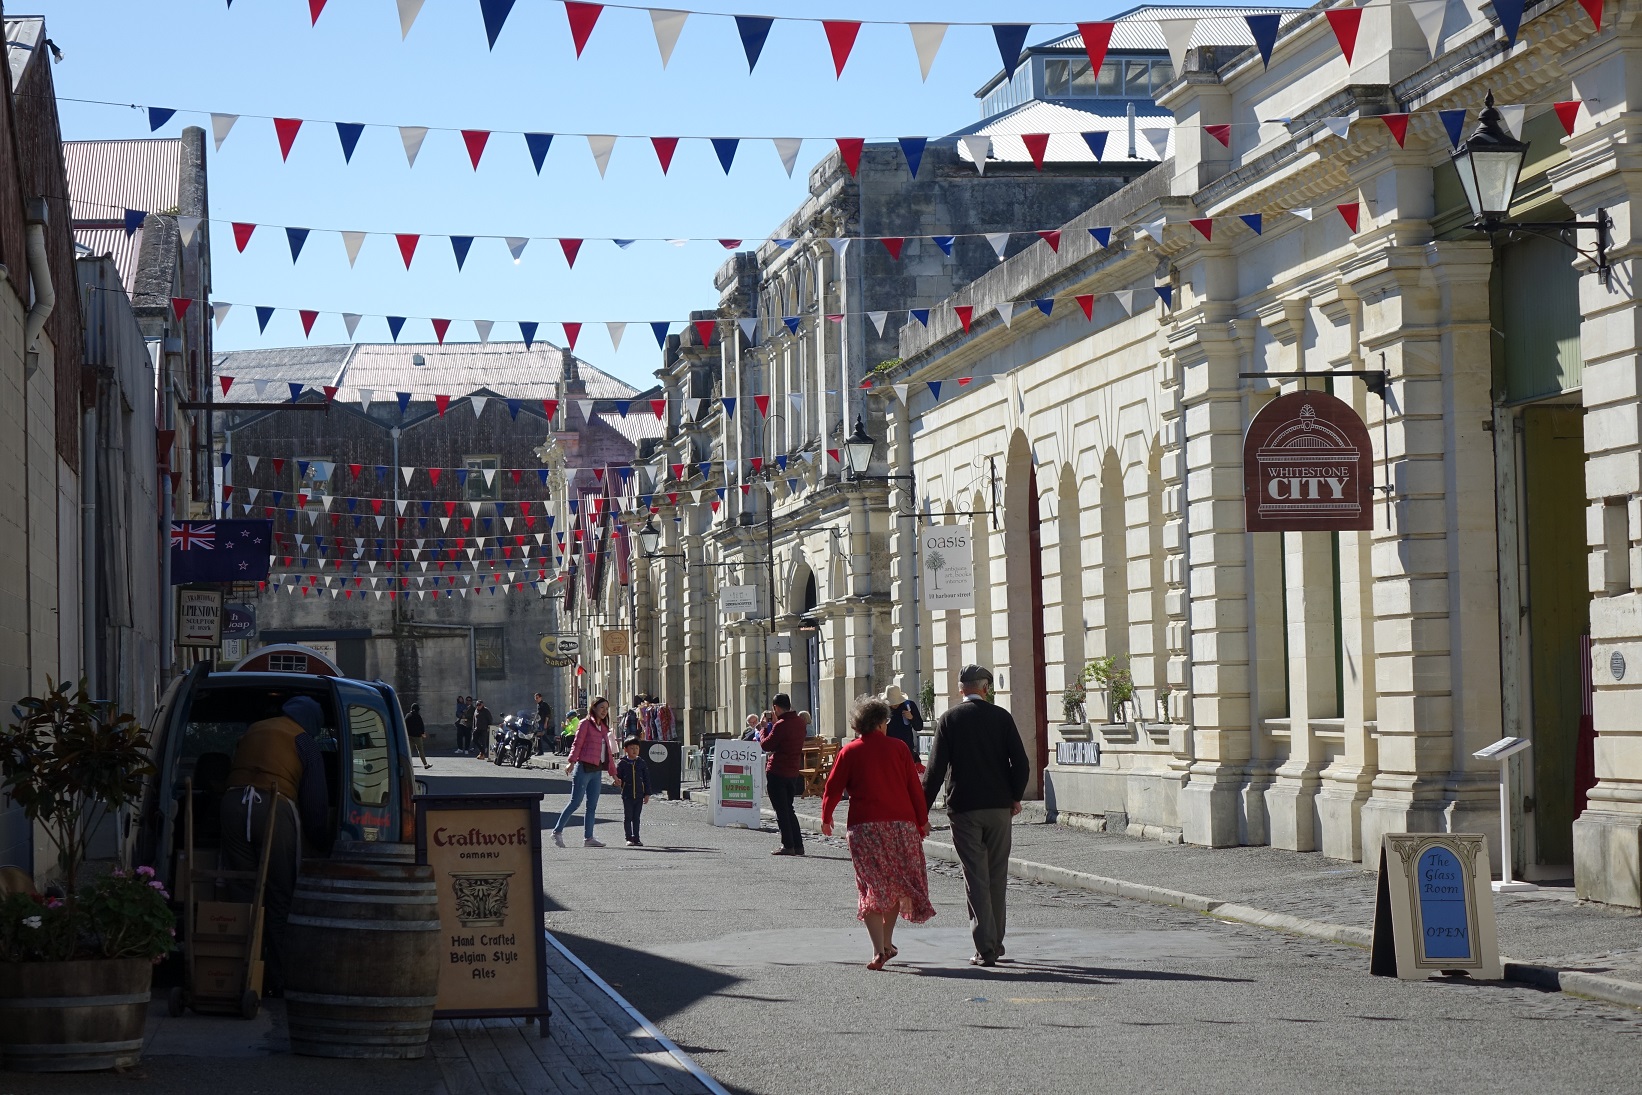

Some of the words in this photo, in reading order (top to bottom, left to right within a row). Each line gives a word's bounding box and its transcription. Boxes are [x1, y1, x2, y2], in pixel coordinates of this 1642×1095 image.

[1267, 466, 1350, 478] WHITESTONE
[1267, 477, 1350, 500] CITY
[181, 604, 220, 618] LIMESTONE
[433, 826, 528, 847] Craftwork
[459, 851, 500, 859] OAMARU
[1428, 853, 1450, 867] The
[1425, 868, 1455, 881] Glass
[1424, 883, 1459, 894] Room
[1426, 926, 1467, 939] OPEN
[451, 935, 475, 947] Hand
[480, 933, 516, 946] Crafted
[450, 951, 487, 965] Belgian
[492, 950, 518, 964] Style
[472, 967, 496, 979] Ales
